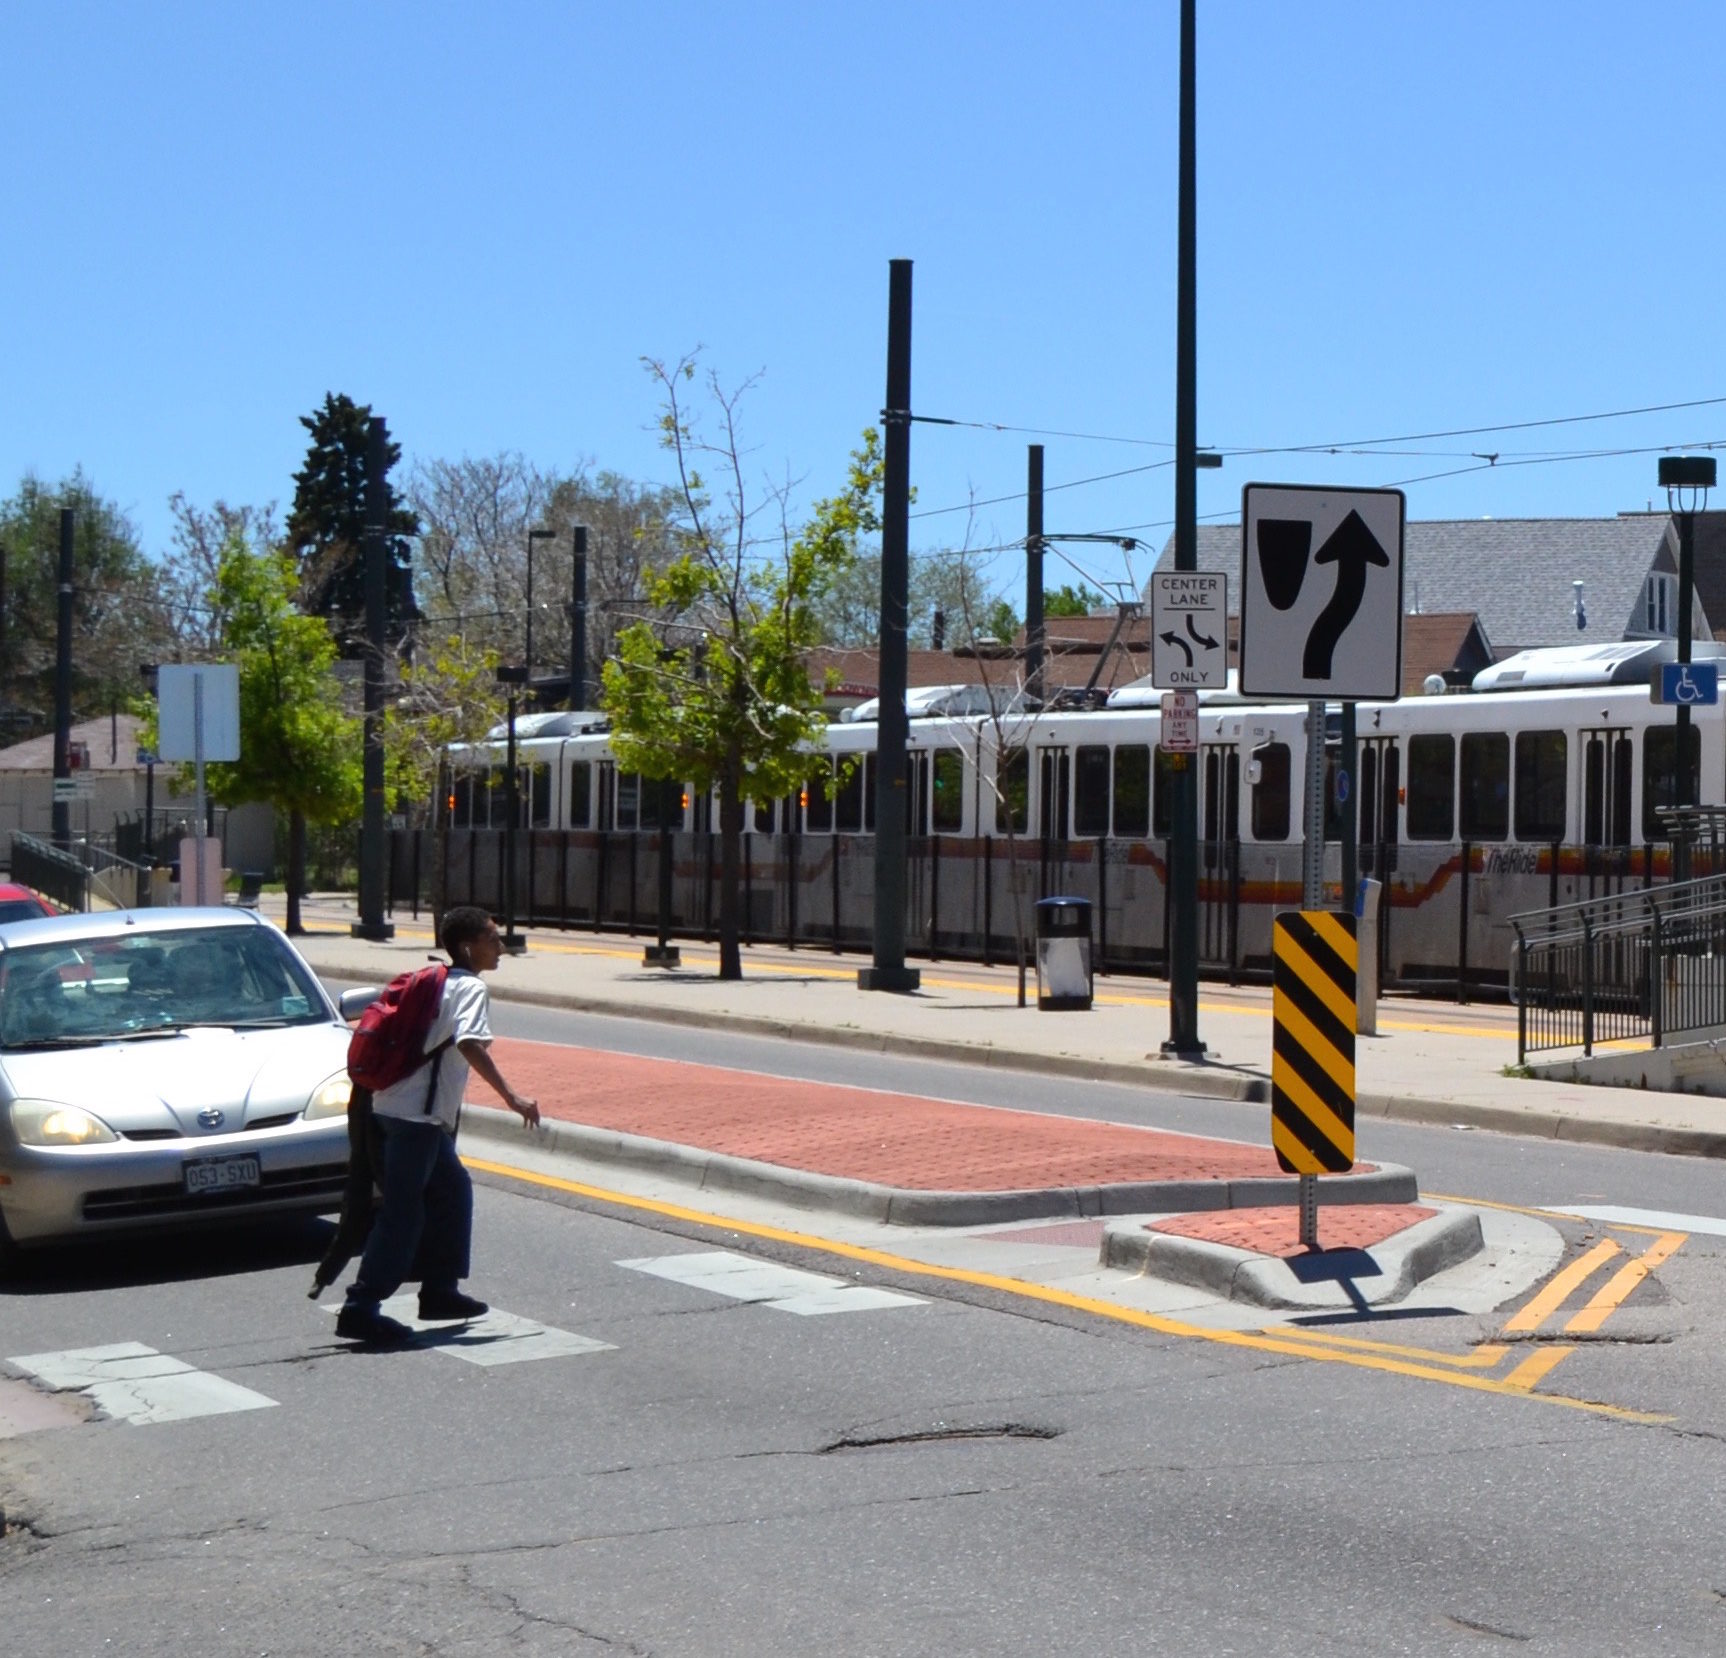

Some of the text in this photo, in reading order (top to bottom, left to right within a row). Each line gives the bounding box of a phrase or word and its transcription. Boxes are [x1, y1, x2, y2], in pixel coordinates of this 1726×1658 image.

[1161, 578, 1217, 590] CENTER
[1170, 594, 1208, 605] LANE
[1170, 671, 1209, 683] ONLY
[1174, 696, 1186, 707] NO
[1163, 708, 1196, 720] PARKING
